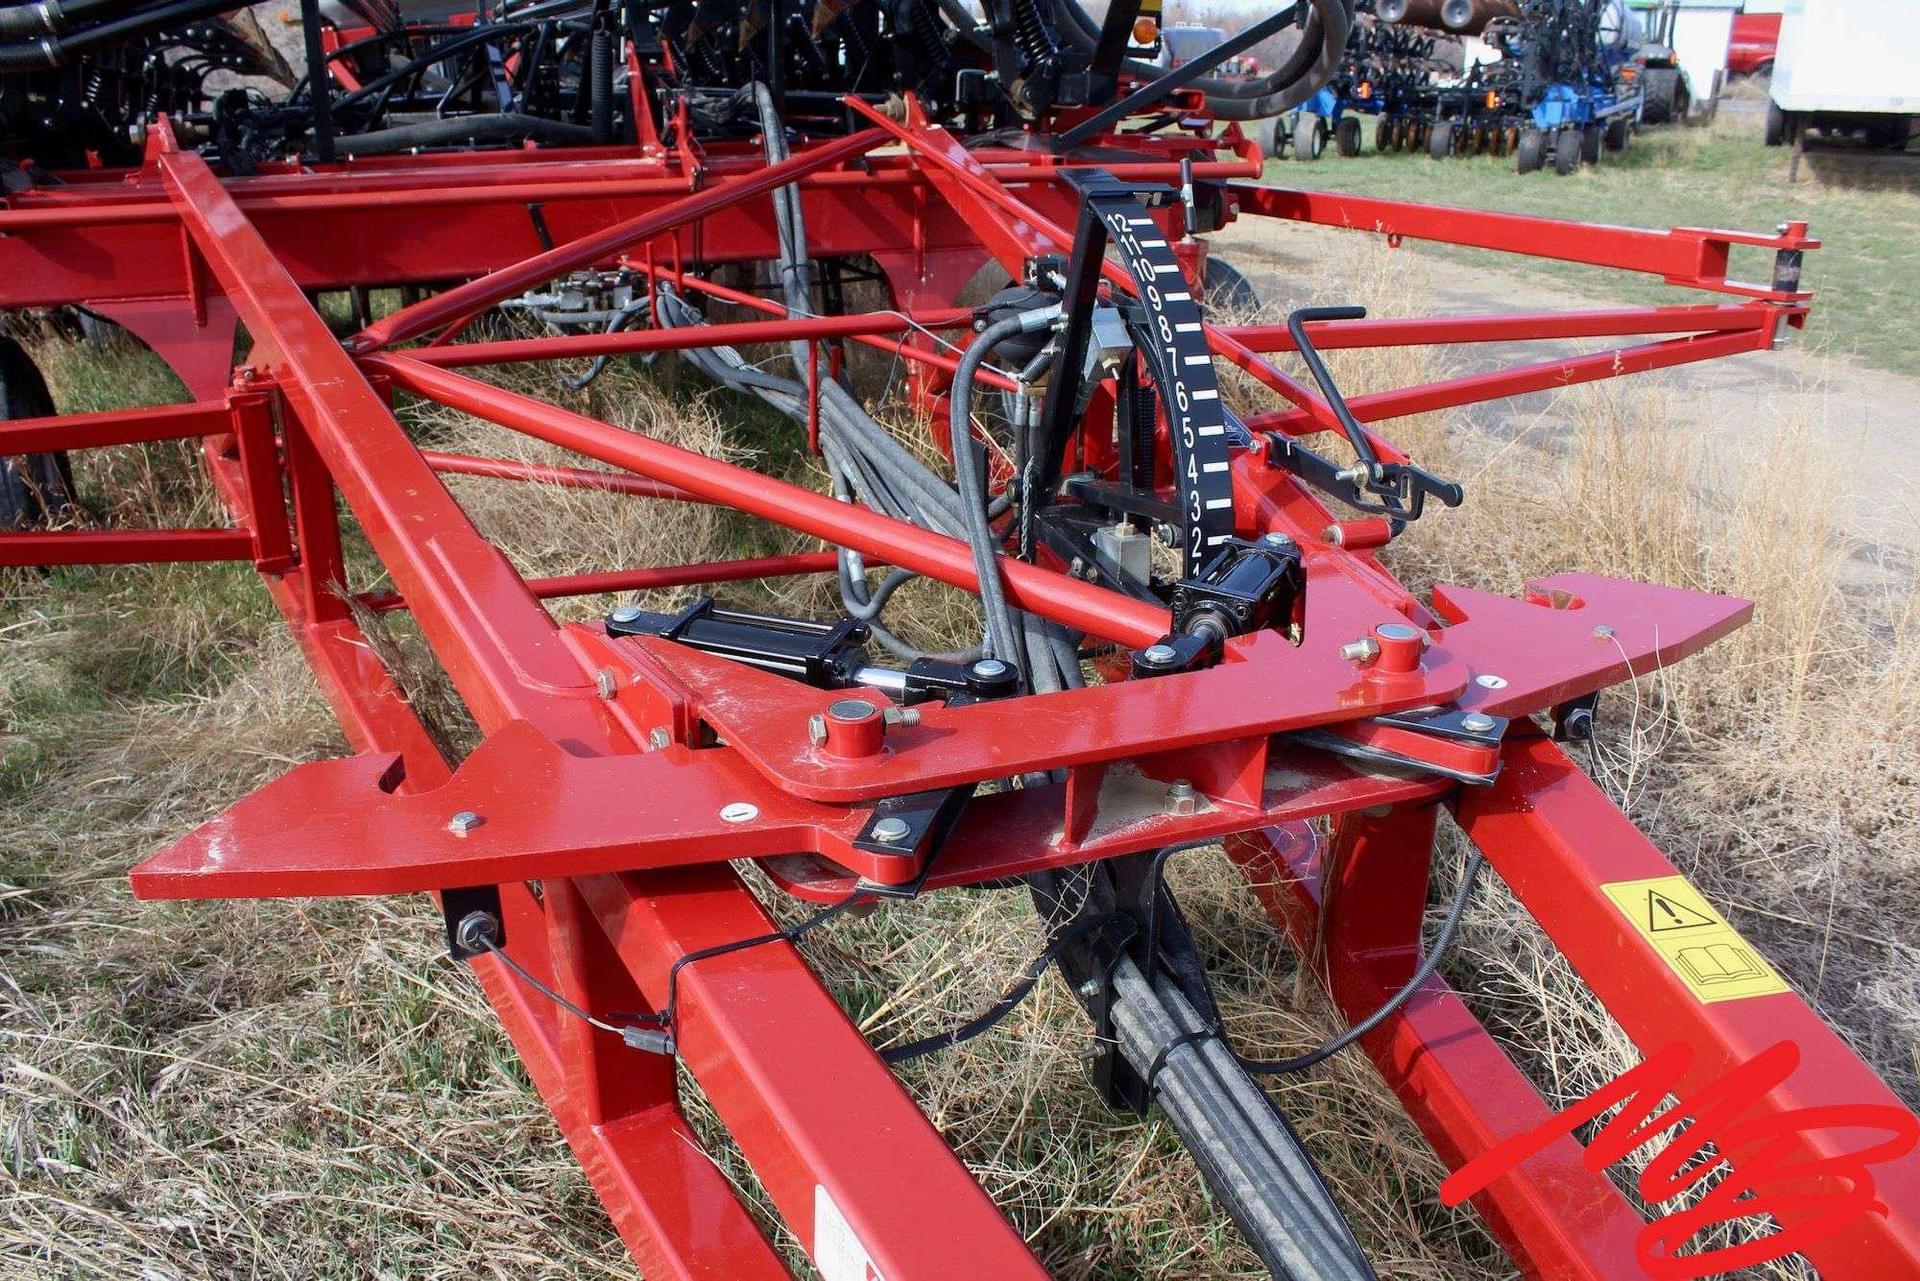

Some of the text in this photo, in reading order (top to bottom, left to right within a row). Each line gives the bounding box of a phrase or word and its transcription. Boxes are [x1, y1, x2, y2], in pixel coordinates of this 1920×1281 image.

[1106, 213, 1132, 232] 12
[1120, 233, 1143, 256] 11
[1132, 258, 1156, 282] 10
[1147, 285, 1162, 312] 9
[1158, 314, 1173, 343] 8
[1166, 347, 1178, 377] 7
[1175, 381, 1189, 413] 6
[1182, 417, 1194, 448] 5
[1187, 453, 1199, 484] 4
[1190, 490, 1201, 522] 3
[1191, 527, 1202, 558] 2
